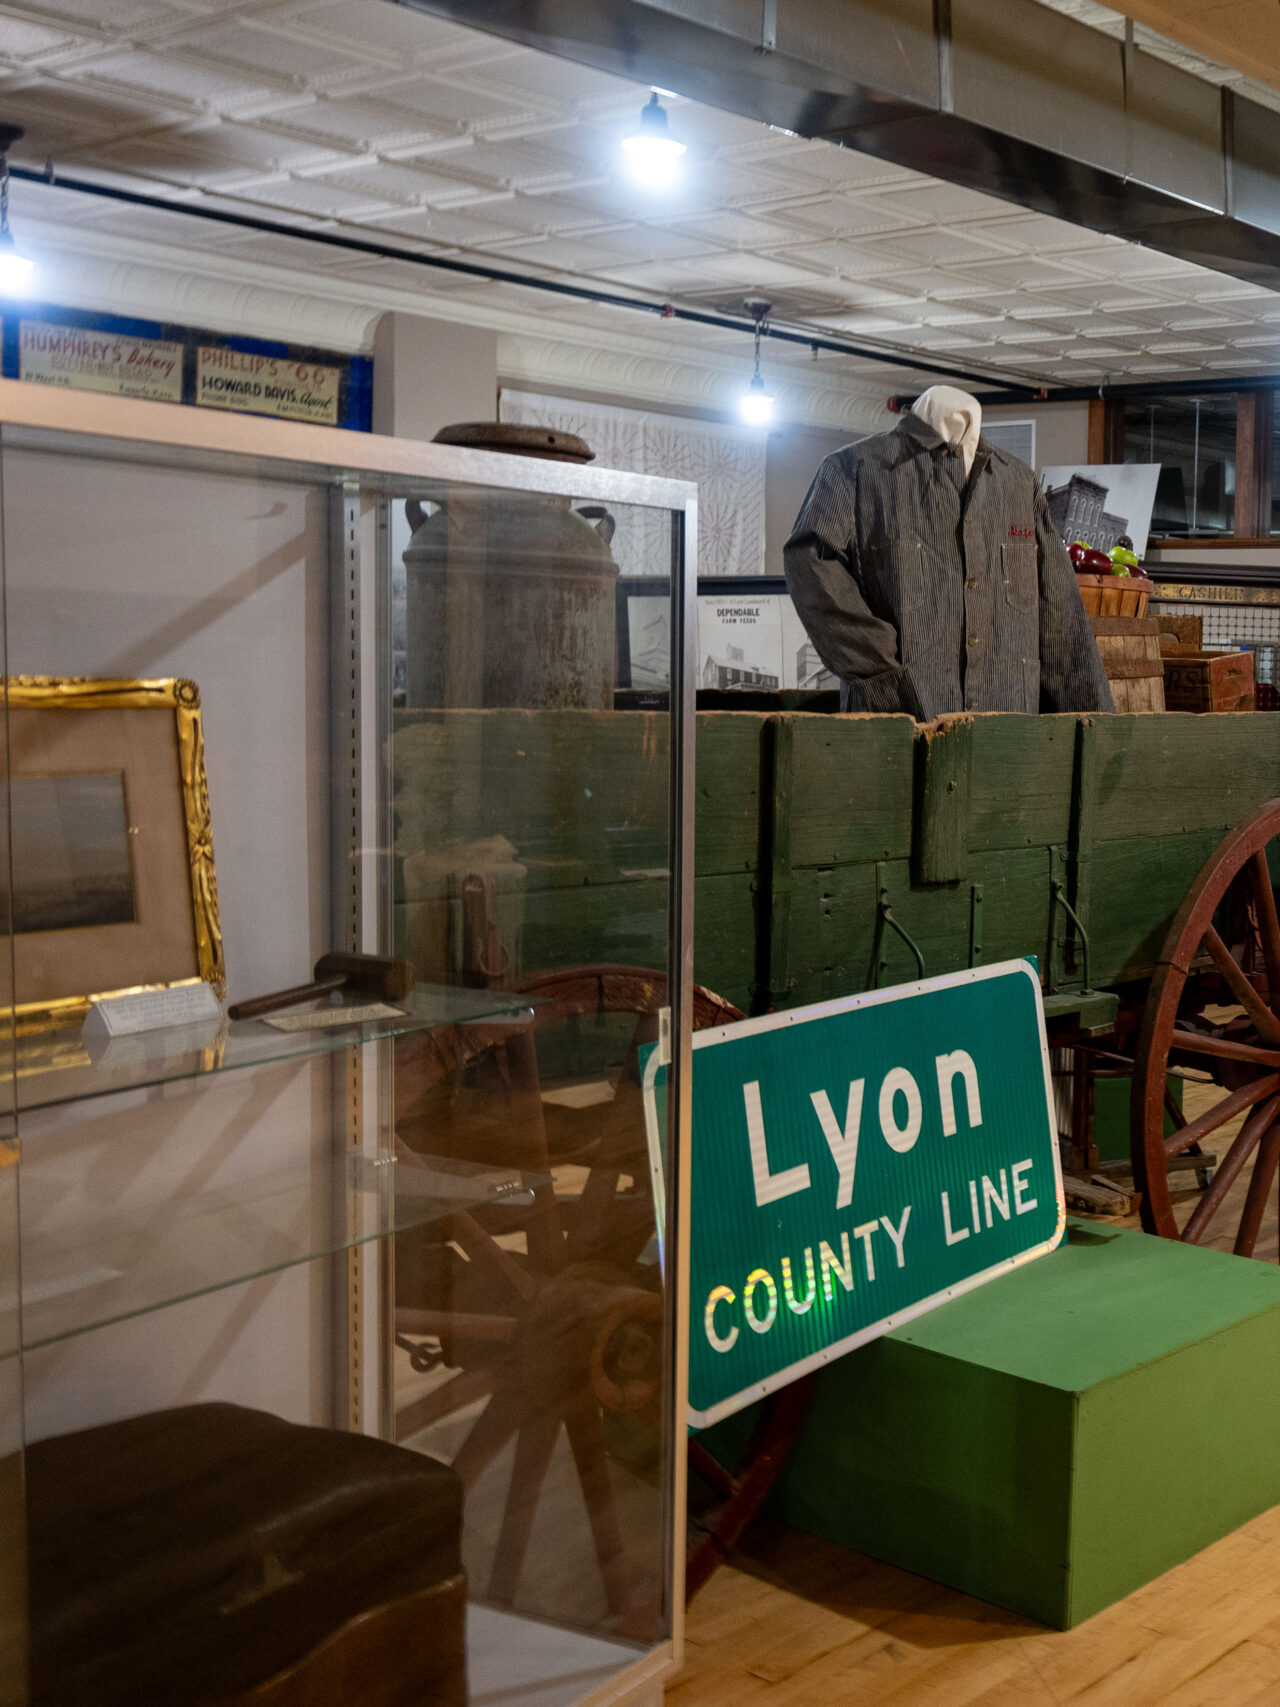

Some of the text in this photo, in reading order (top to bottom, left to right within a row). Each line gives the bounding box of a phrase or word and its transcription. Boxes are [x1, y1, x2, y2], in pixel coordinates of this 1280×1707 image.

[126, 346, 176, 379] Bakery
[201, 350, 278, 376] PHILLIP'S
[202, 375, 262, 397] HOWARD
[299, 391, 334, 410] Agent
[1178, 585, 1245, 601] CASHIER
[716, 608, 760, 617] DEPENDABLE
[742, 1048, 983, 1210] Lyon
[704, 1158, 1038, 1353] COUNTY LINE
